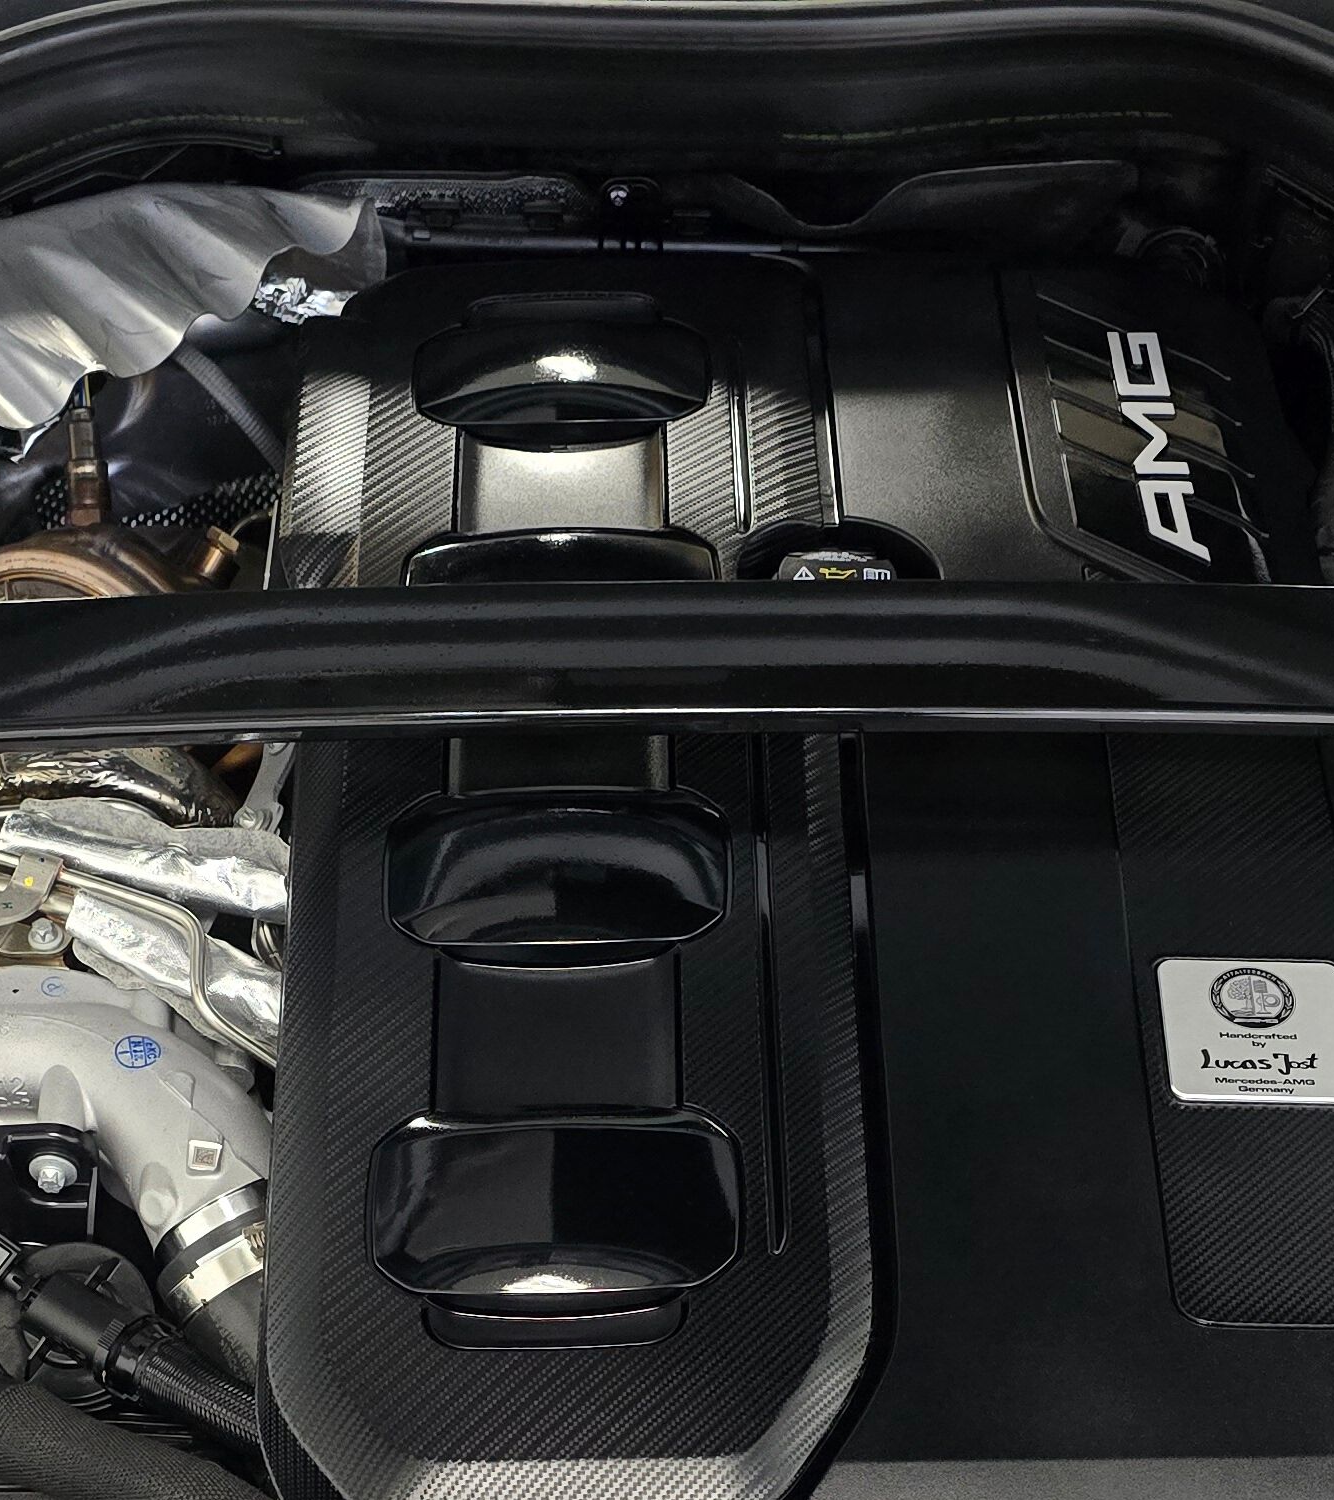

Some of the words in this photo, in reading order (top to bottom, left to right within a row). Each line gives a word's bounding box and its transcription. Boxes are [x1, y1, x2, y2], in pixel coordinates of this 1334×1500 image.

[1107, 332, 1211, 564] AMG
[1219, 1031, 1298, 1040] Handcrafted
[1252, 1040, 1266, 1048] by
[1200, 1049, 1272, 1070] Lucas
[1273, 1053, 1319, 1075] Jost
[1215, 1076, 1316, 1086] Mercedes-AMG
[1238, 1085, 1295, 1094] Germany
